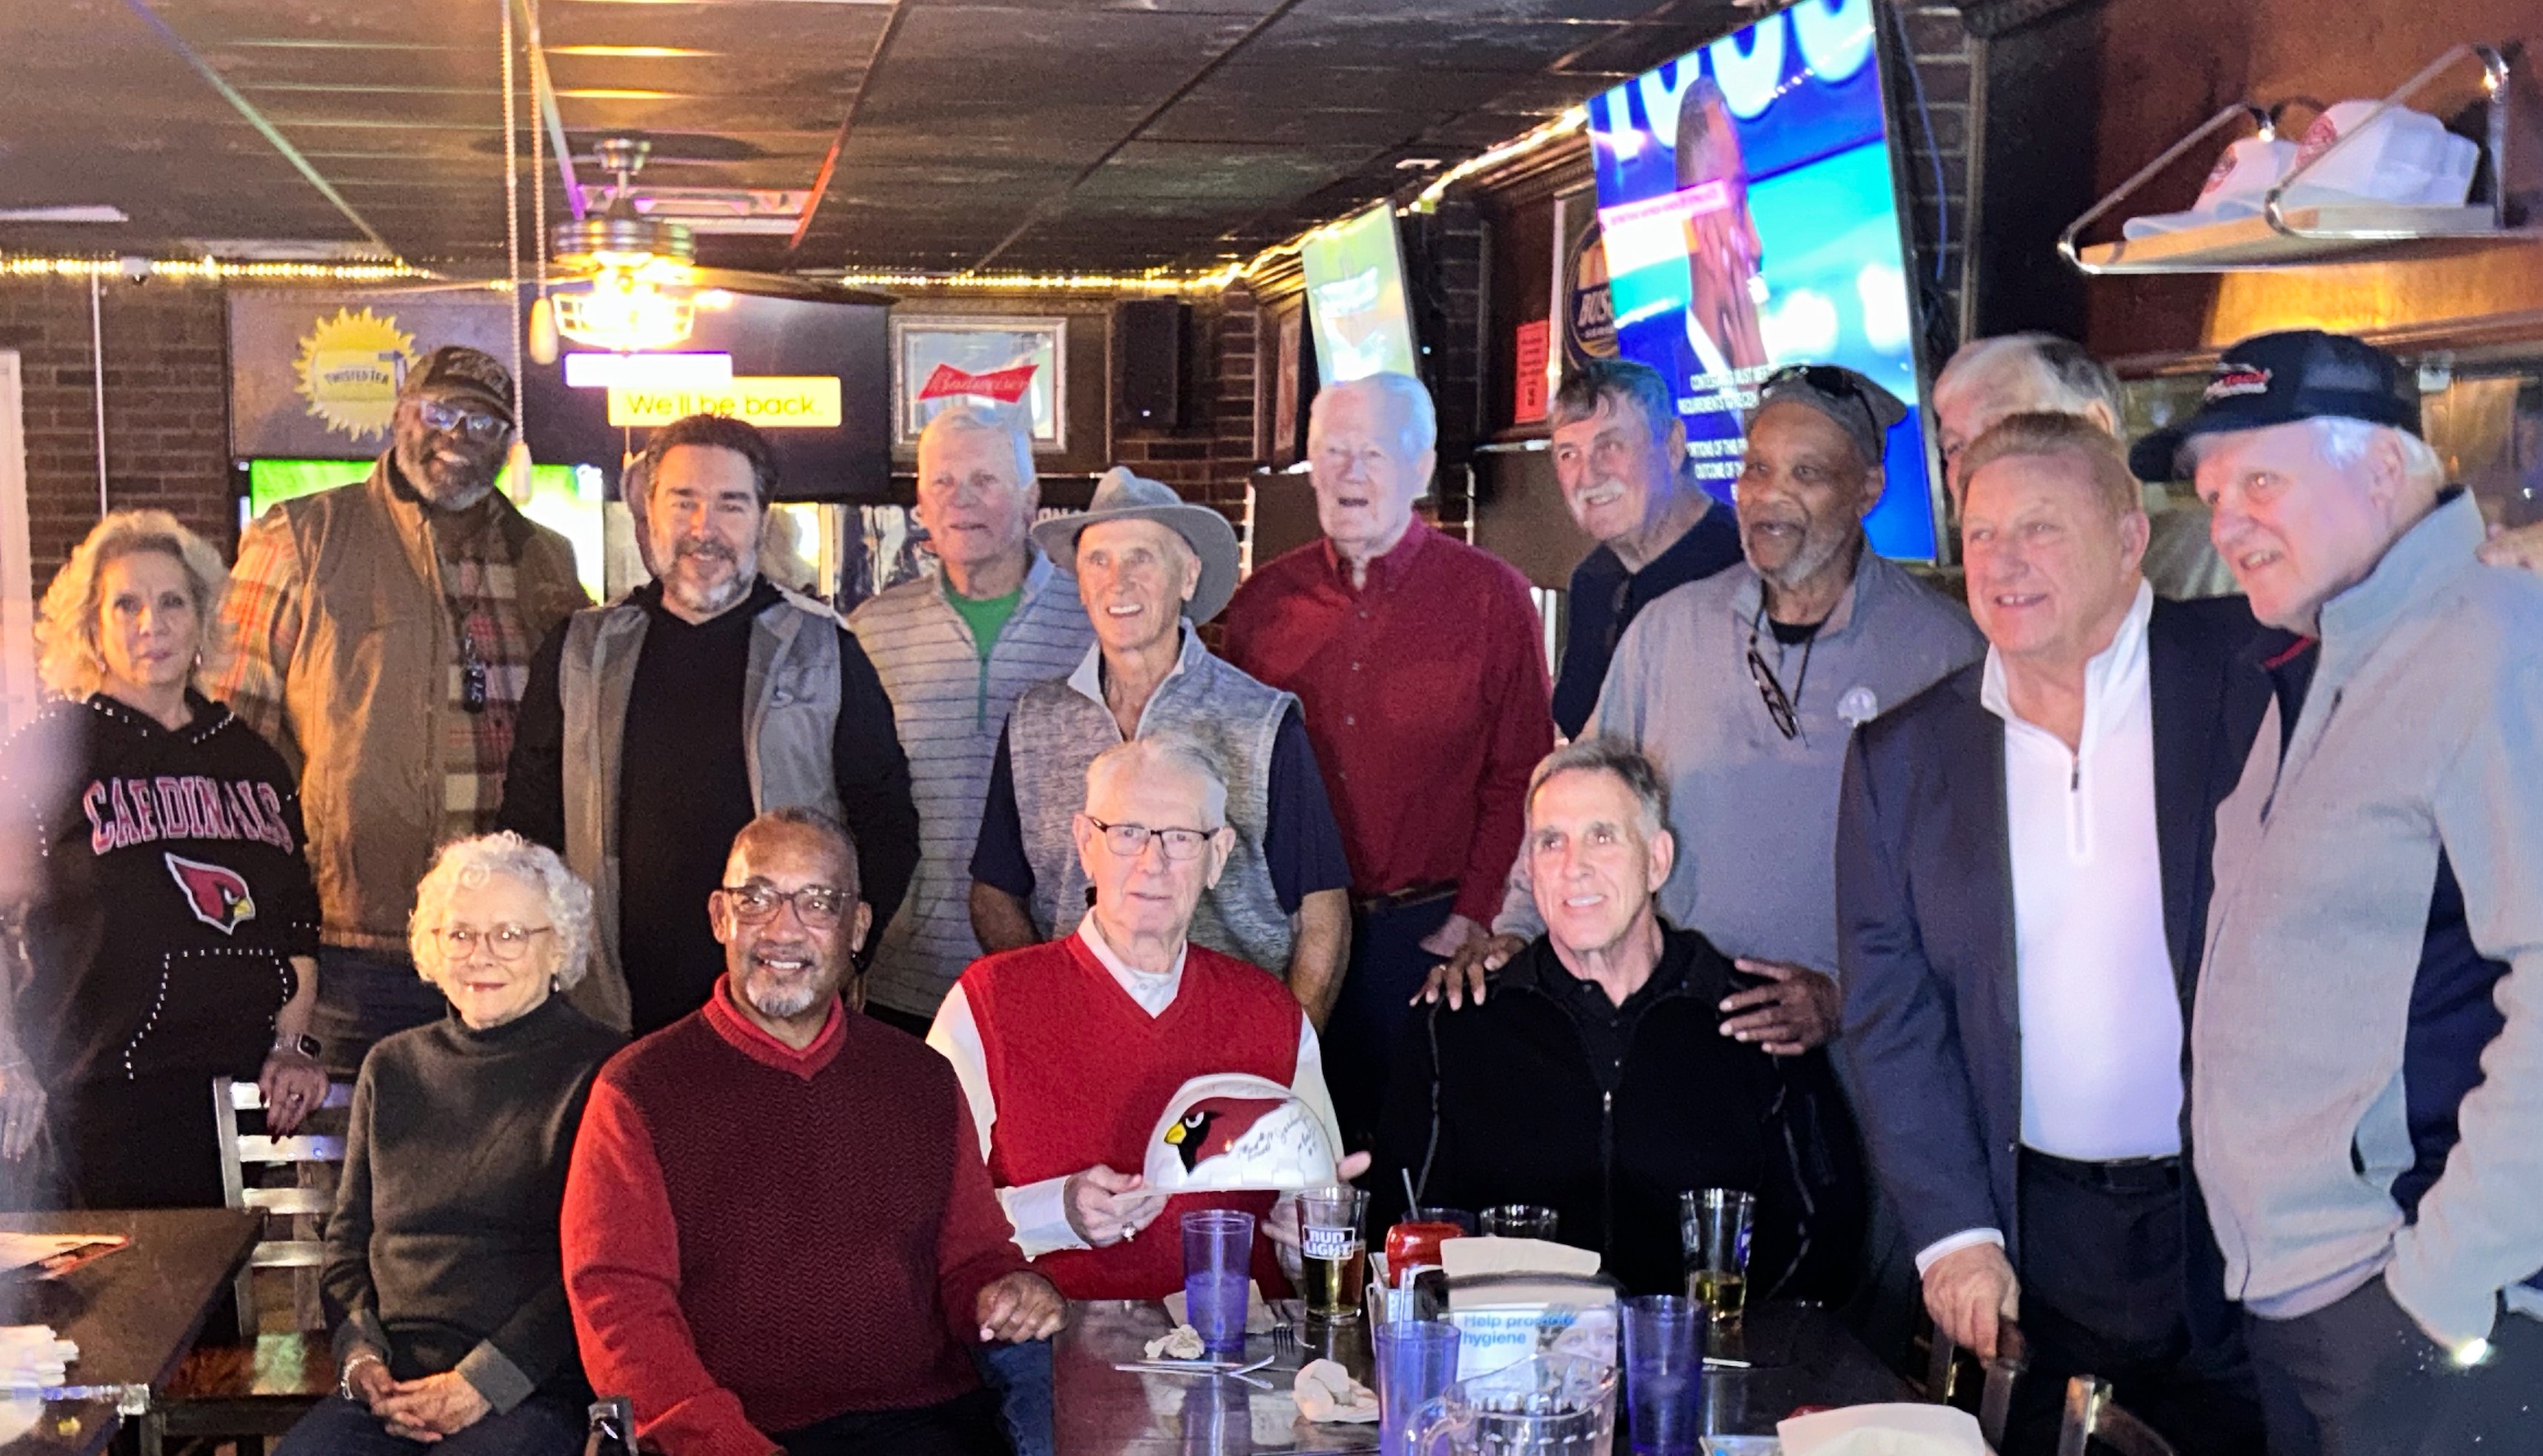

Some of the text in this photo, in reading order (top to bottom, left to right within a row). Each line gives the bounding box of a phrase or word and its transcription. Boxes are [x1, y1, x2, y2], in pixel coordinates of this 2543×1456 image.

[700, 393, 736, 416] be
[83, 775, 294, 856] CARDINALS
[1304, 1229, 1352, 1256] BUD LIGHT
[1463, 1314, 1501, 1328] Help
[1462, 1329, 1527, 1347] hygiene
